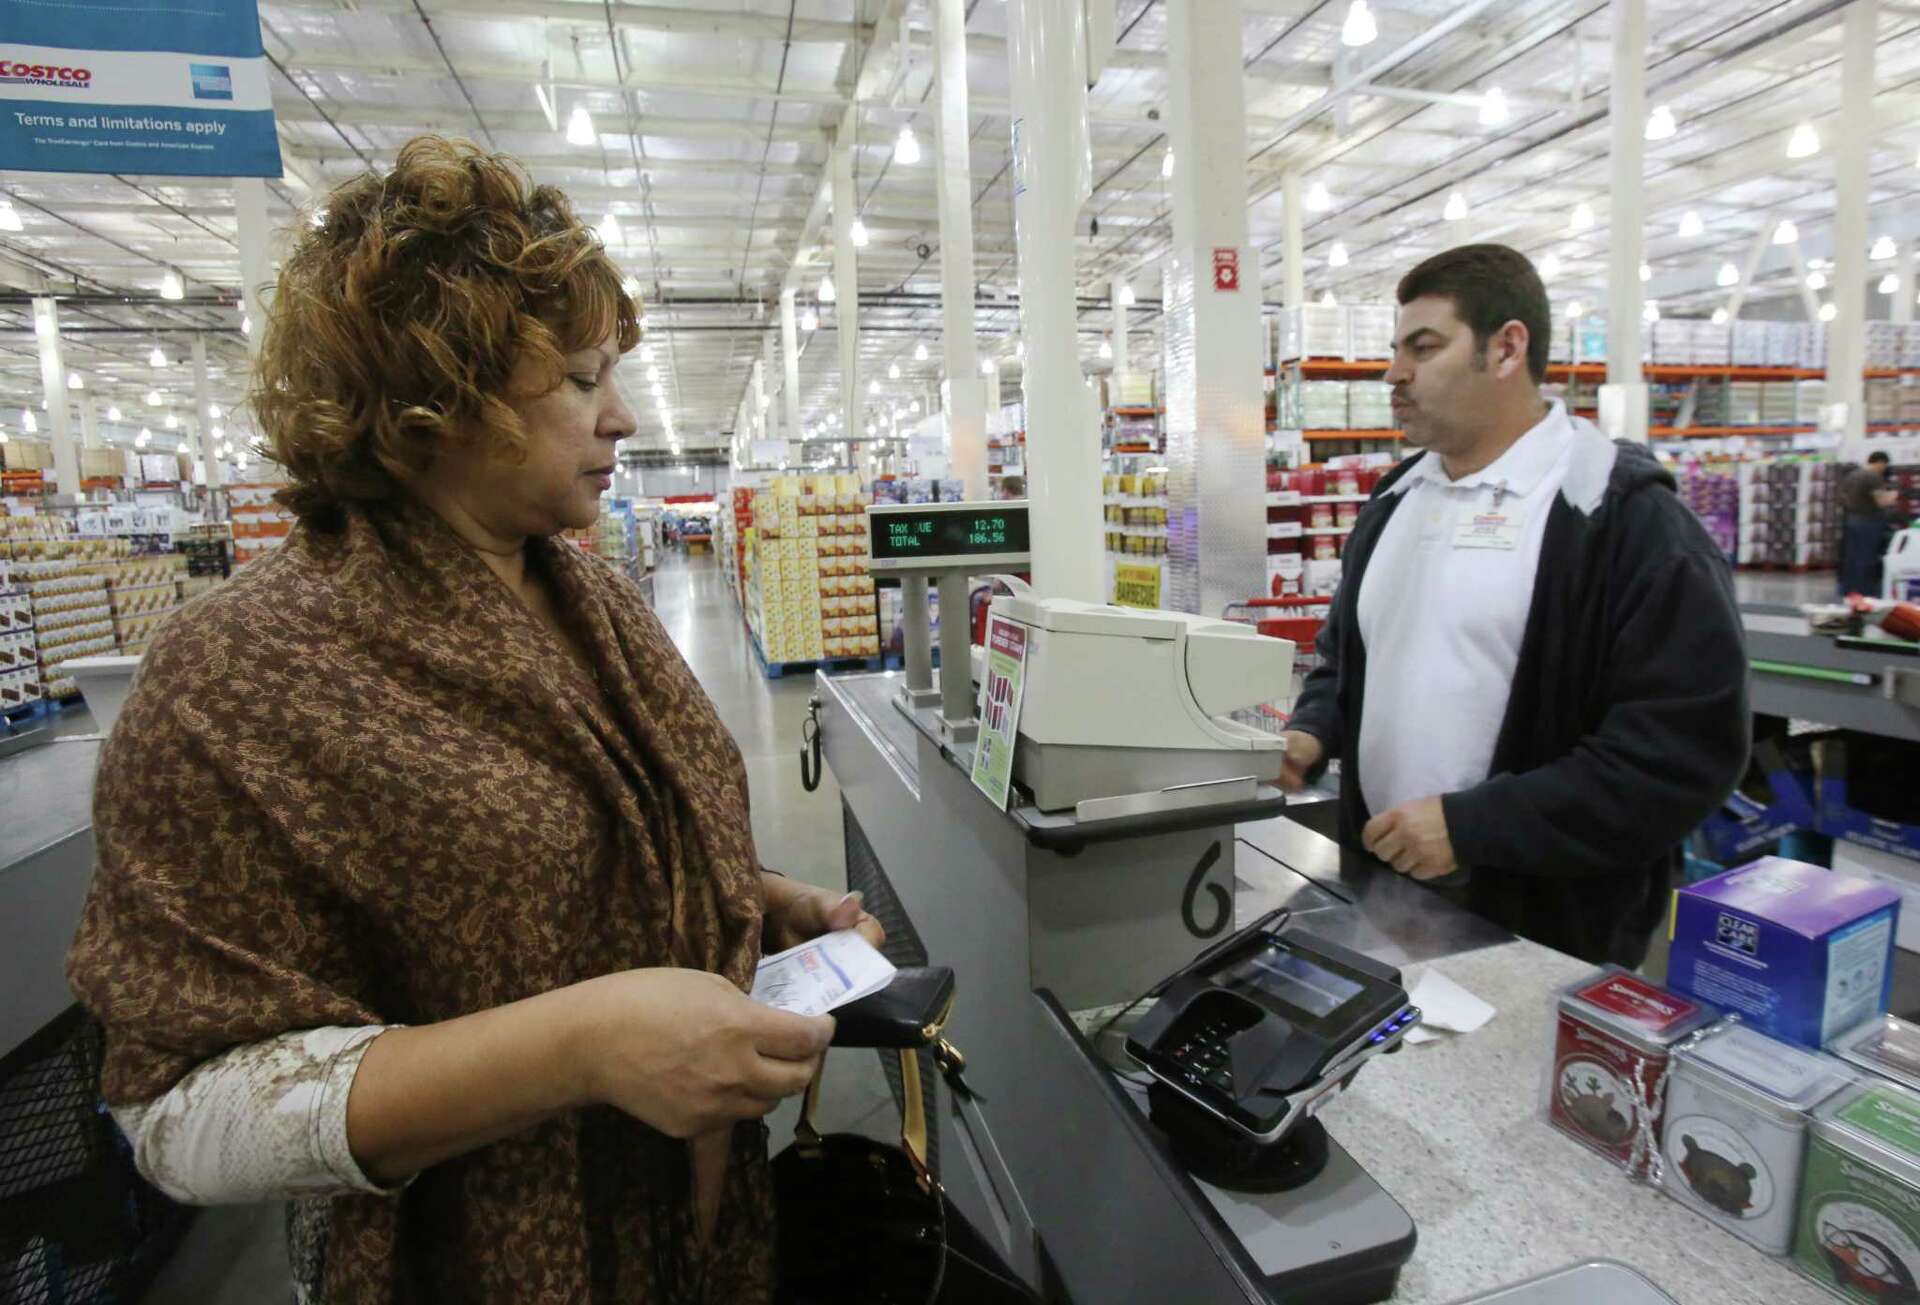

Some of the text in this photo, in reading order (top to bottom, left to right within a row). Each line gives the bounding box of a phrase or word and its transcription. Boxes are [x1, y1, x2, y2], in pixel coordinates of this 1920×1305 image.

[0, 60, 92, 81] COSTCO
[25, 78, 89, 88] WHOLESALE
[14, 112, 226, 135] Terms and limitations apply
[889, 523, 909, 535] TAX
[974, 519, 1005, 530] 12.70
[890, 535, 920, 547] TOTAL
[1182, 840, 1231, 939] 6
[1719, 916, 1755, 934] CLEAR
